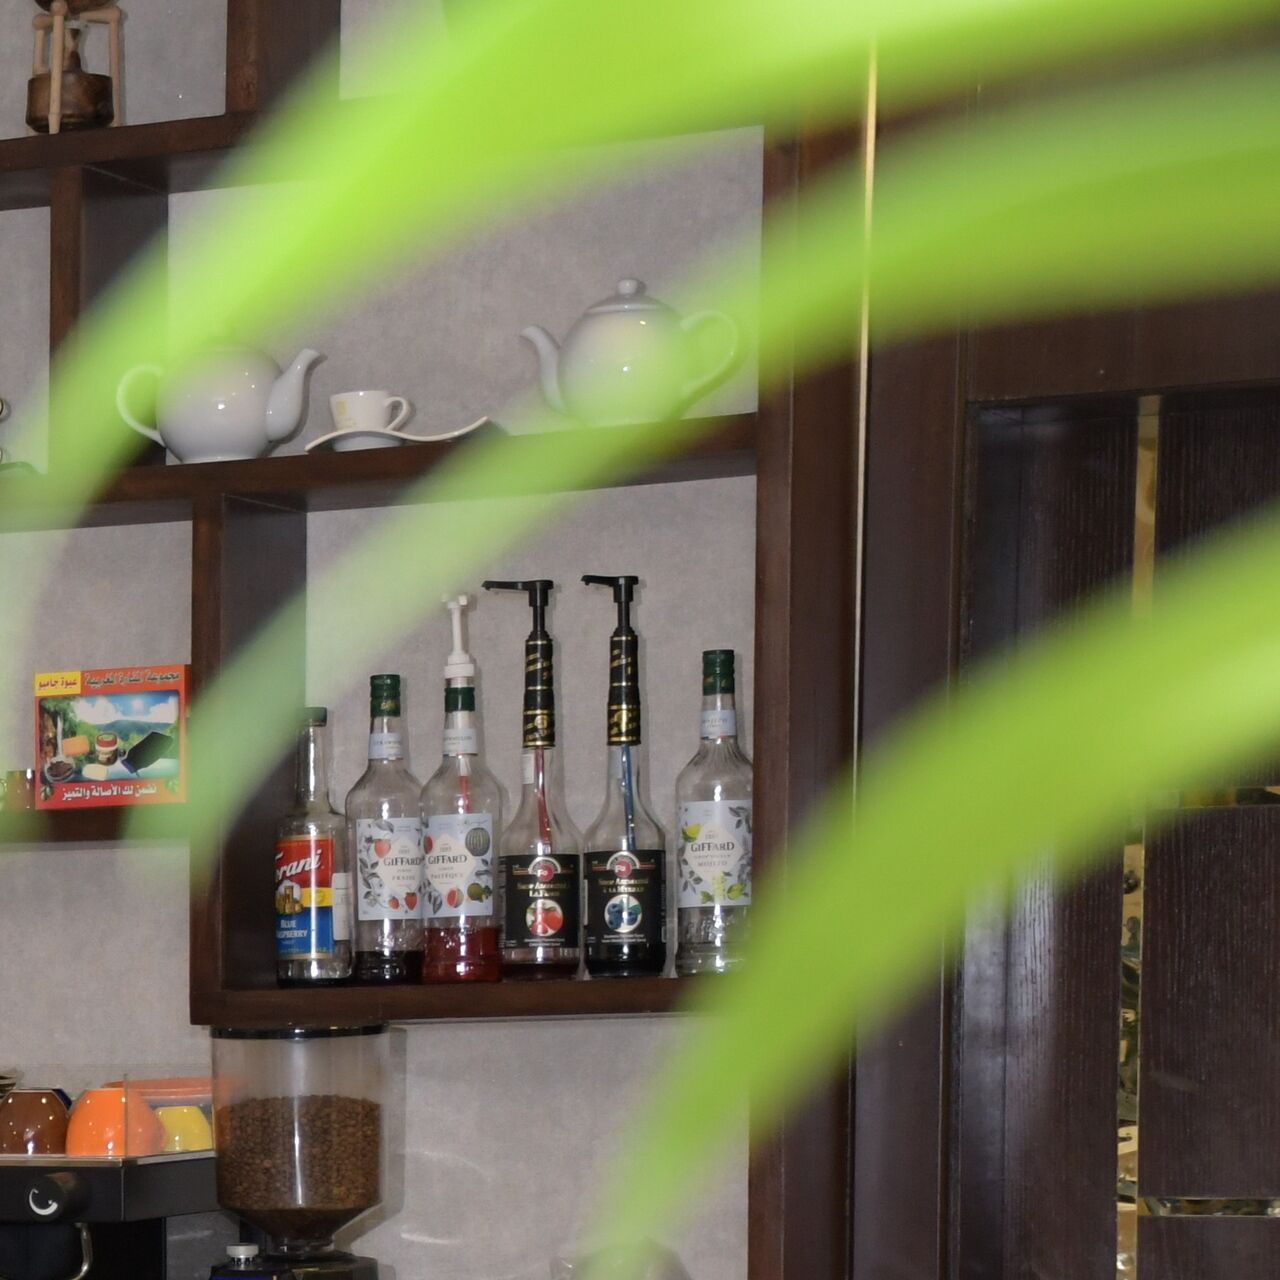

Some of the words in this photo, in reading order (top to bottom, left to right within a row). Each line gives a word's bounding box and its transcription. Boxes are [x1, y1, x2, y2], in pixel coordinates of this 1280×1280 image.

[690, 841, 735, 852] GIFFARD
[383, 856, 421, 867] GIFFARD
[427, 854, 468, 865] GIFFARD
